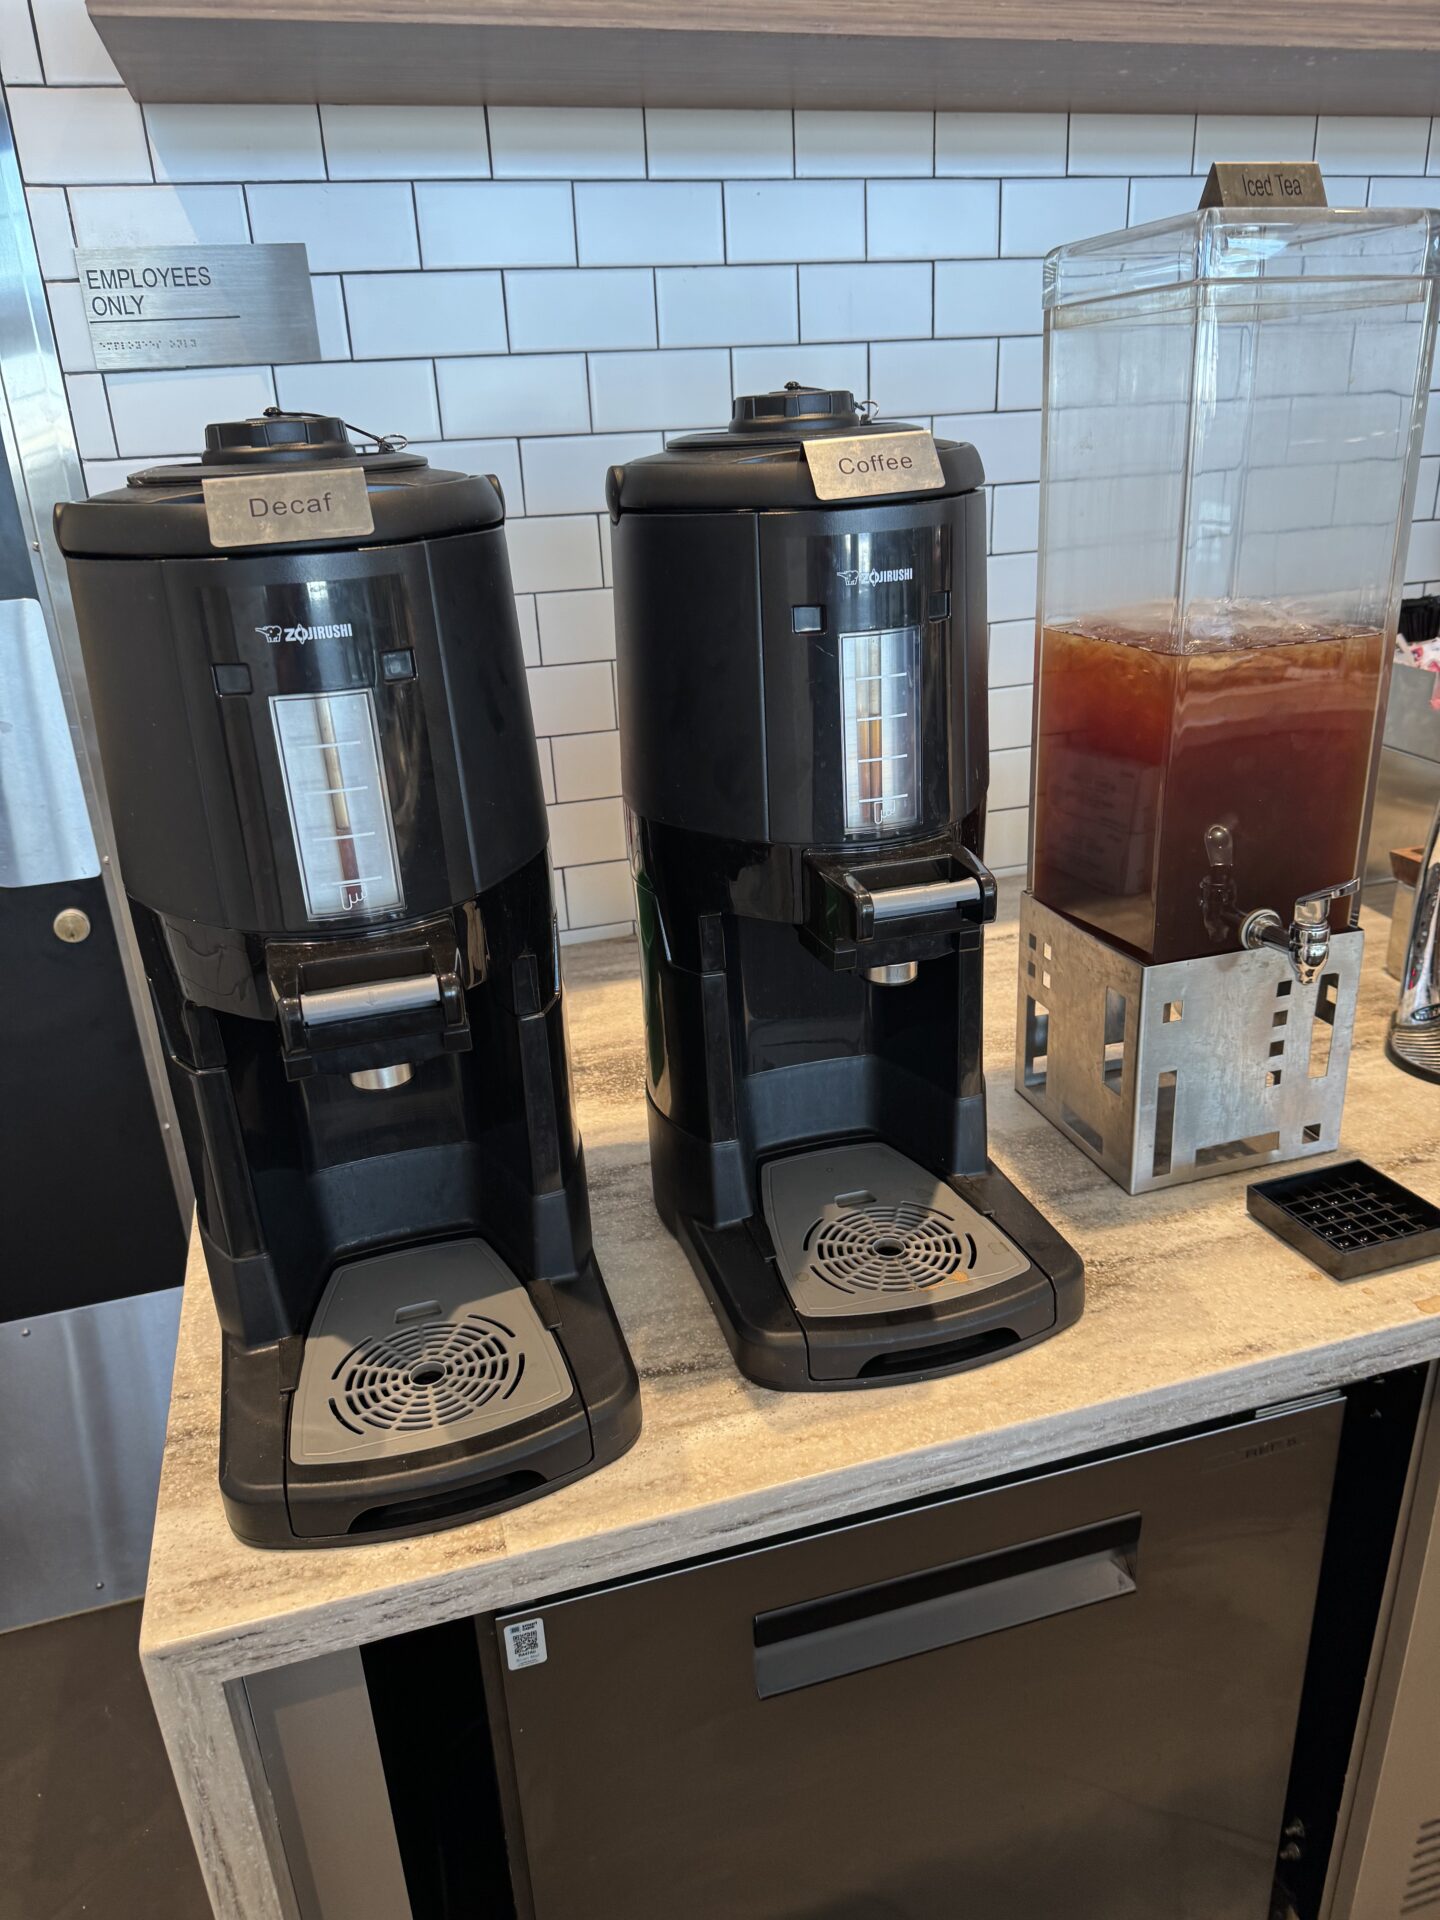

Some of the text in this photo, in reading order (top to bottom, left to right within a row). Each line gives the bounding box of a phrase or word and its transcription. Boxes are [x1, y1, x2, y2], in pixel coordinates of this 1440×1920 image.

[1242, 173, 1302, 196] Iced Tea
[86, 266, 212, 290] EMPLOYEES
[92, 295, 145, 316] ONLY
[838, 454, 913, 475] Coffee
[249, 492, 333, 518] Decaf
[859, 567, 913, 588] ZOJIRUSHI
[284, 623, 353, 645] ZOJIRUSHI
